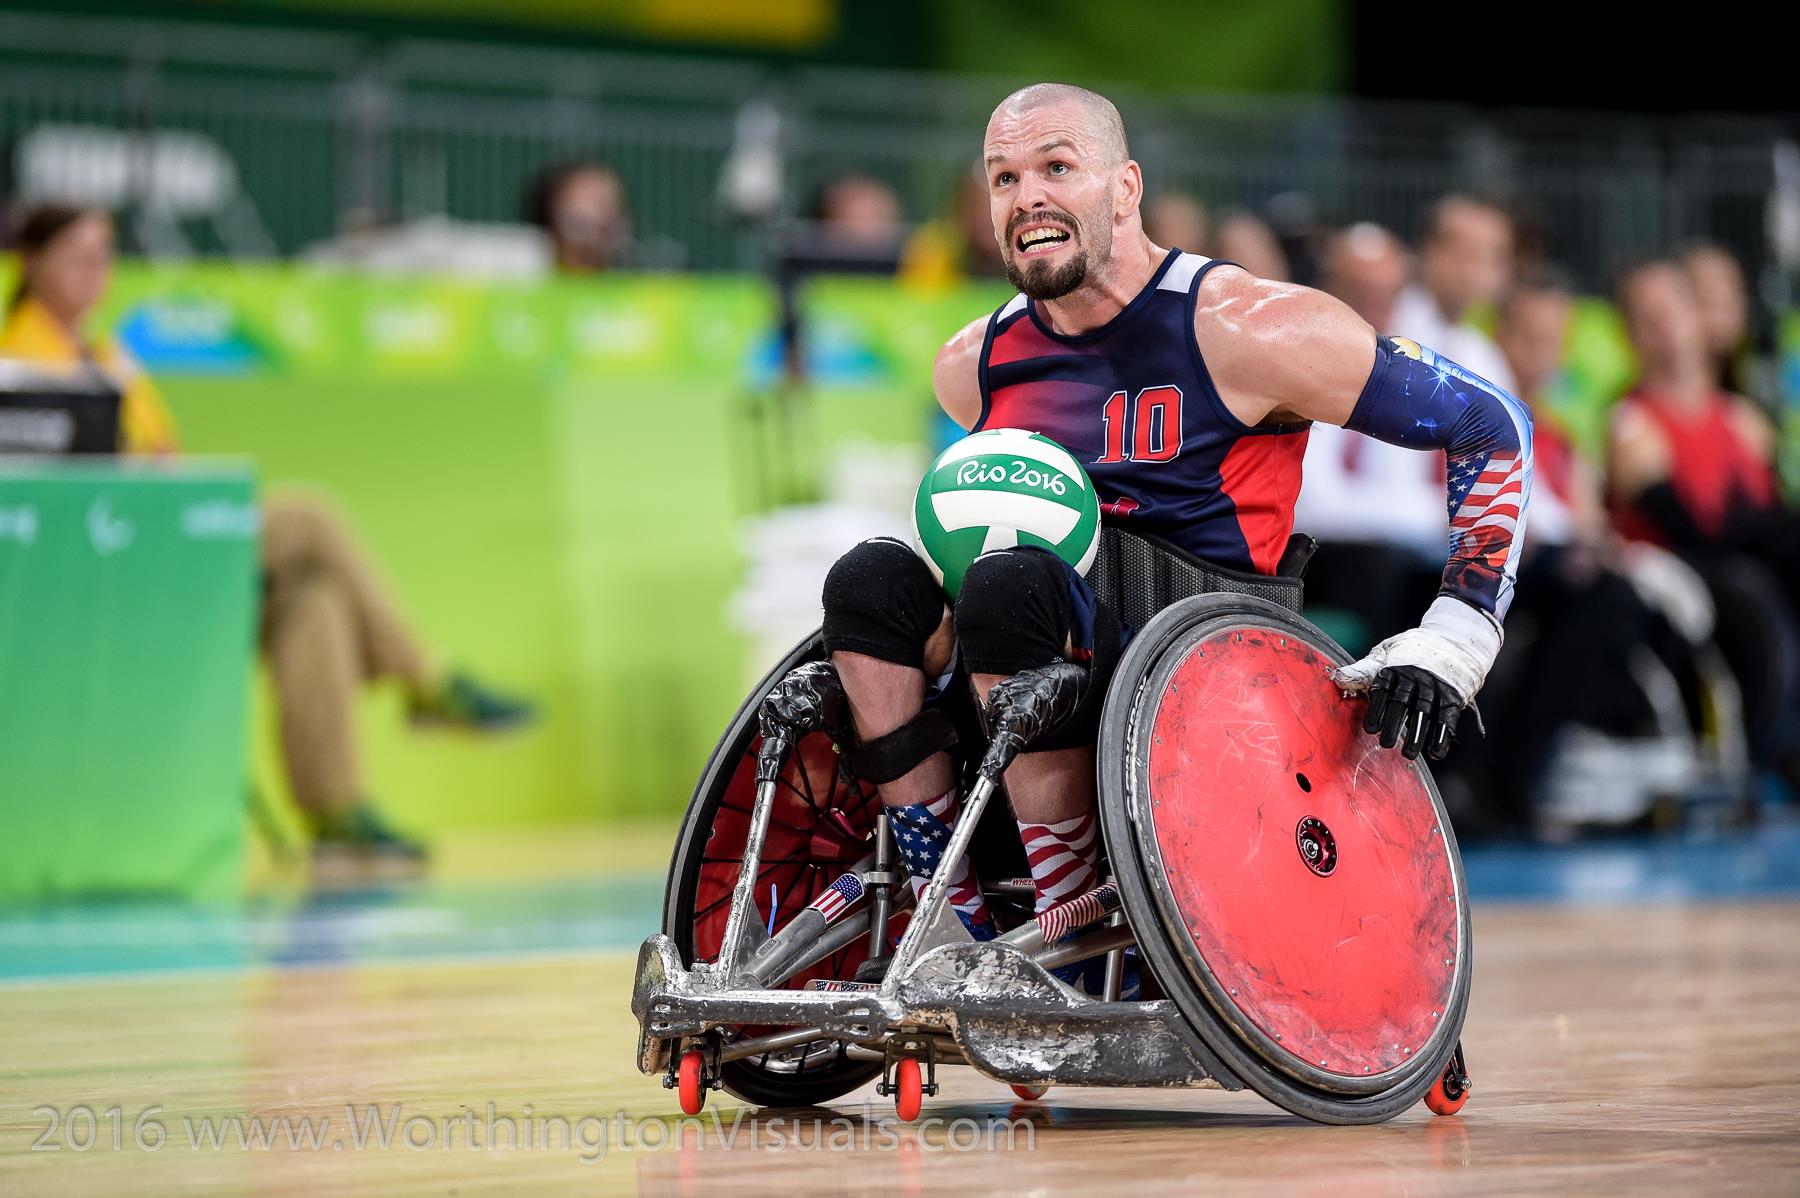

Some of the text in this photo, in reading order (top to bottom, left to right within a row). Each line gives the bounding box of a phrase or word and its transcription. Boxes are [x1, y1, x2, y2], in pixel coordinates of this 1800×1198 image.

[1095, 384, 1183, 464] 10
[957, 460, 1066, 496] Rio 2016
